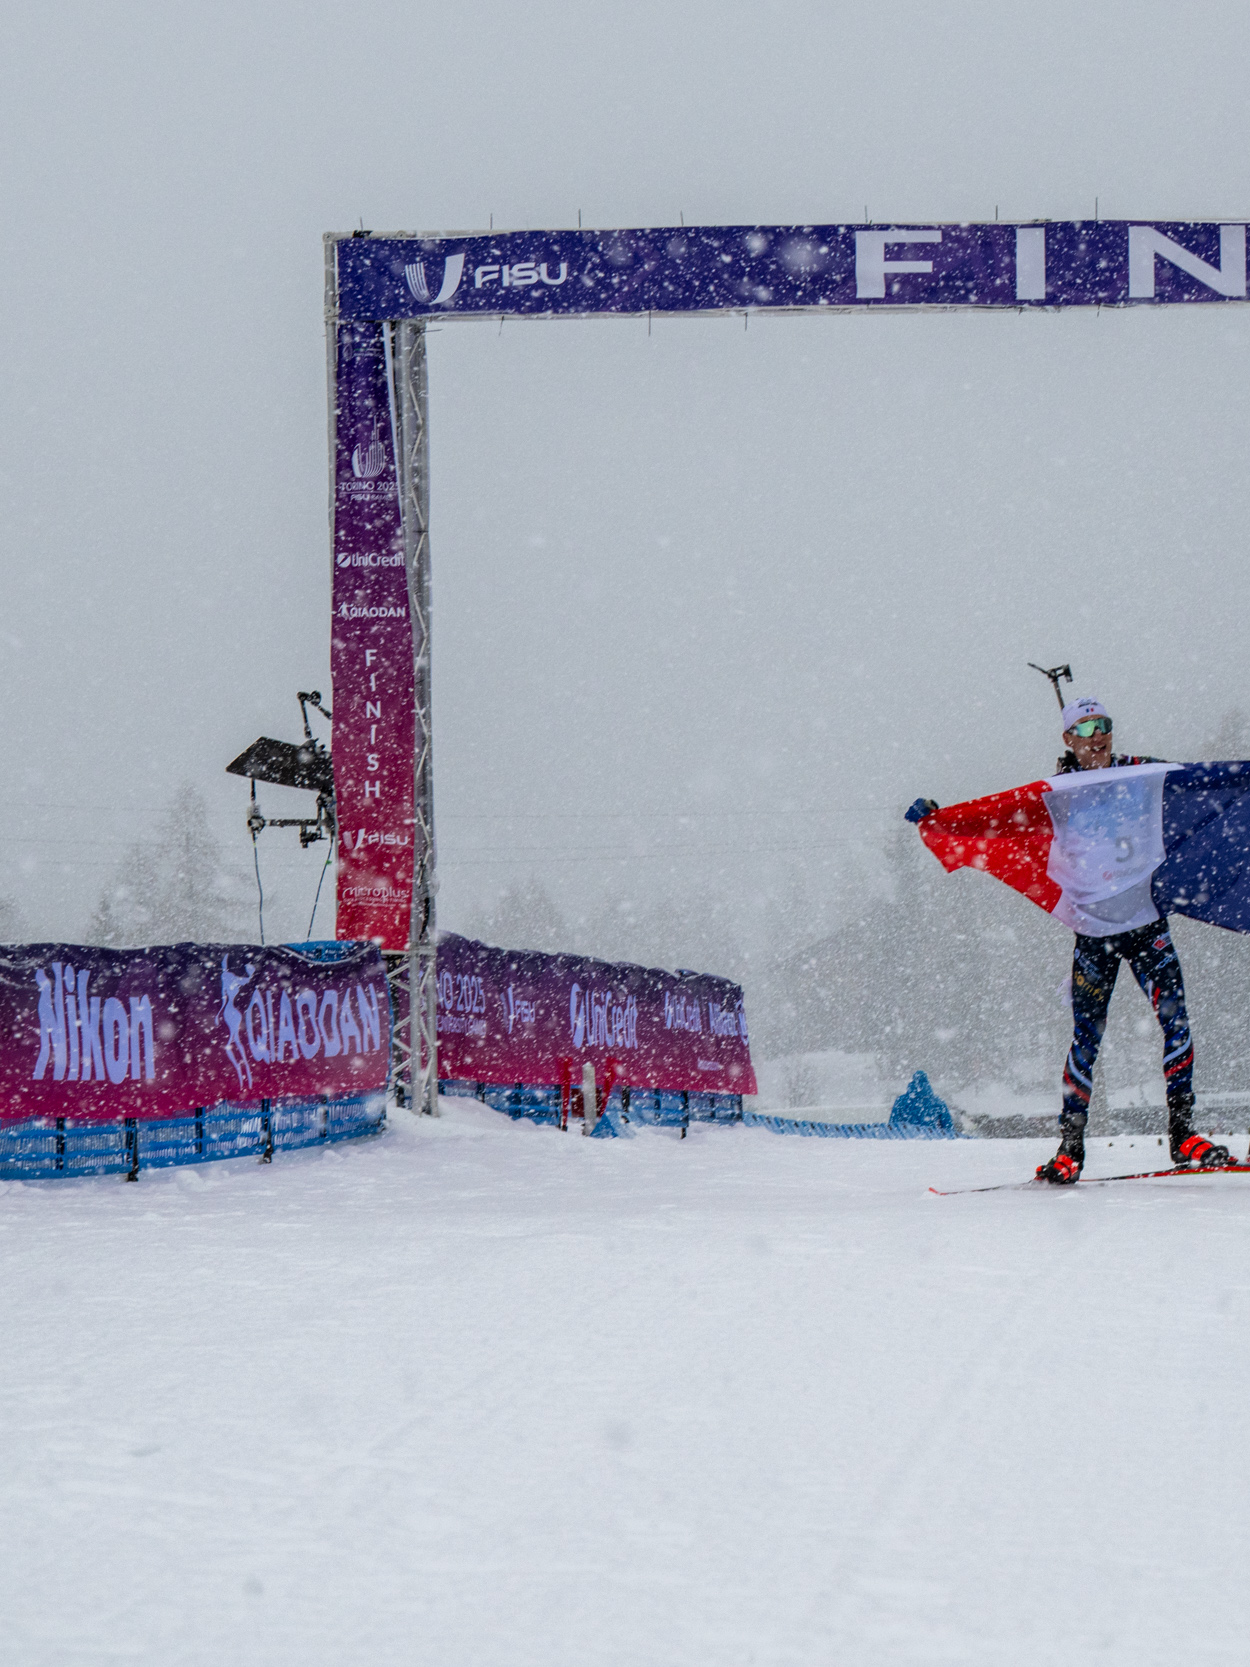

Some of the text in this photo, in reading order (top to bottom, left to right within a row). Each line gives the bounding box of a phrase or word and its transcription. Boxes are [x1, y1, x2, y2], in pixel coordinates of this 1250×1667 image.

[474, 262, 567, 288] FISU
[352, 553, 405, 567] UniCredit
[350, 607, 406, 617] QIAODAN
[364, 649, 381, 798] FINISH
[368, 834, 408, 845] FISU
[456, 973, 486, 1014] 2025
[33, 961, 155, 1084] Nikon
[246, 983, 381, 1063] QIAODAN
[586, 990, 638, 1049] UniCredit
